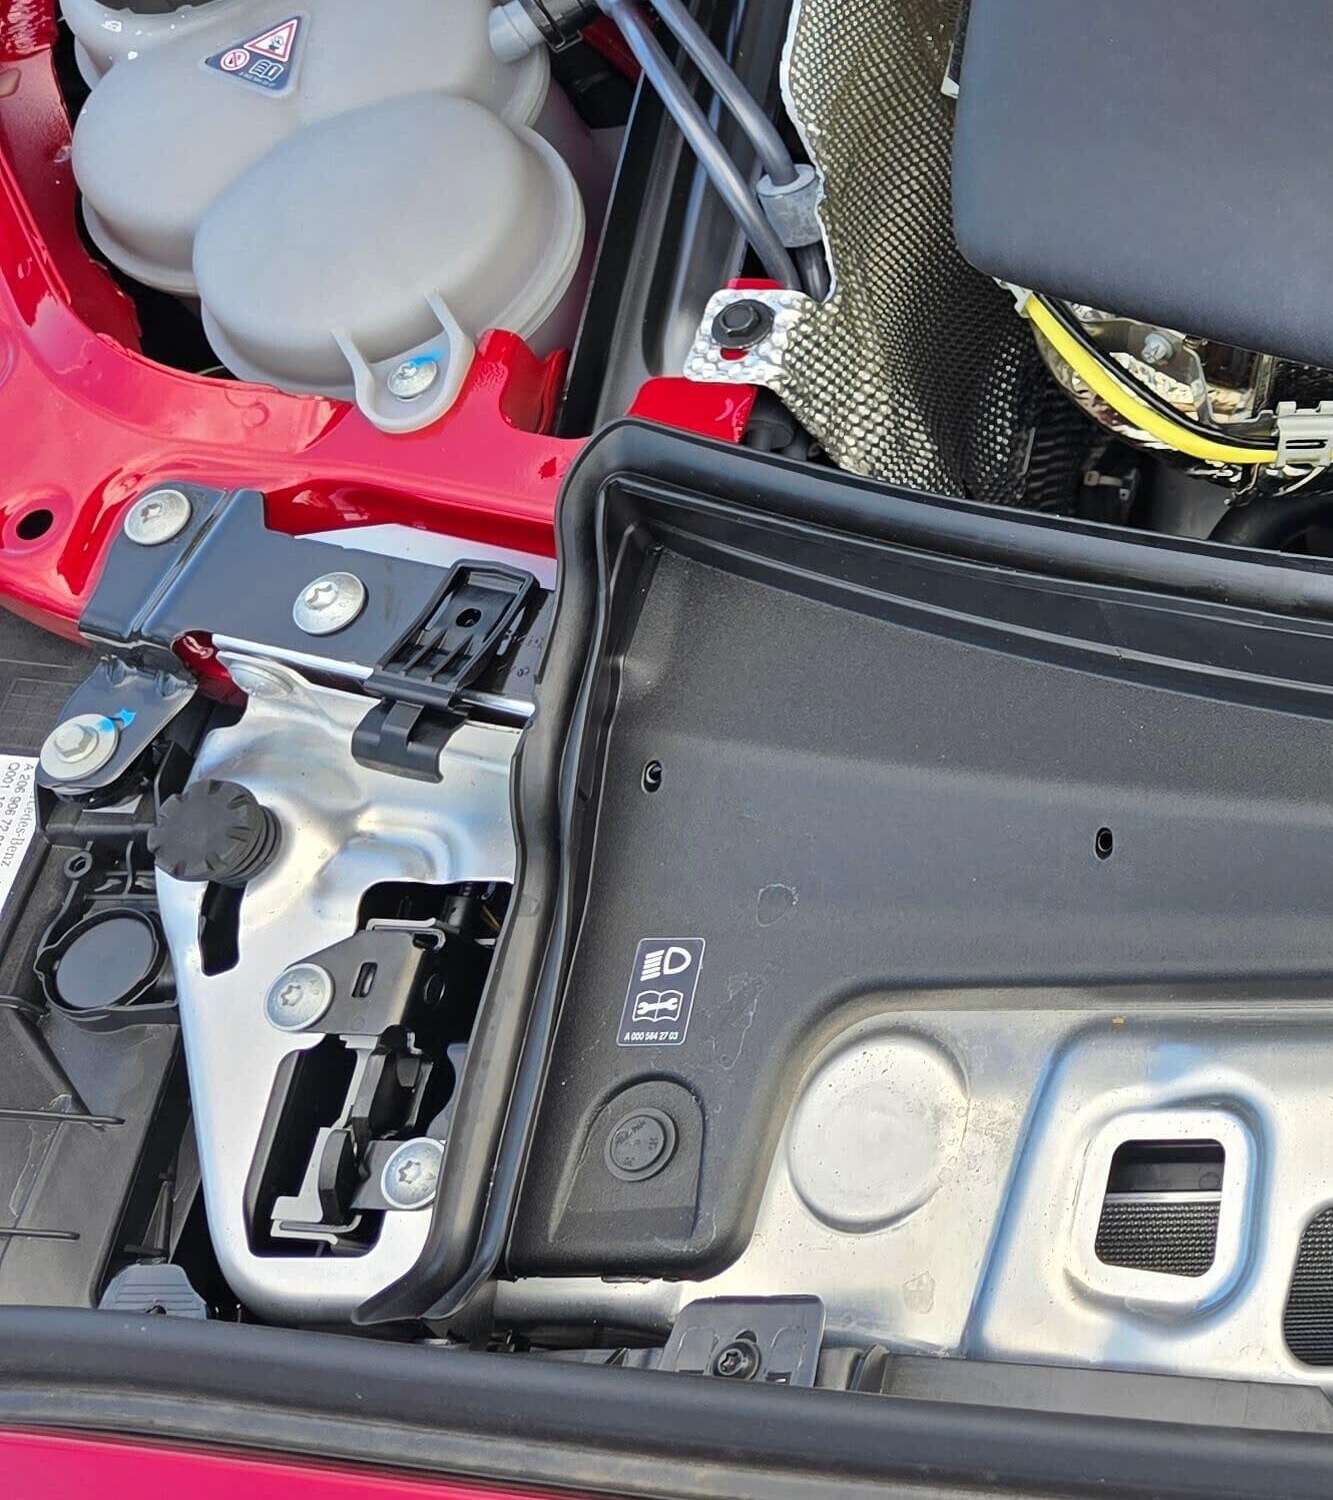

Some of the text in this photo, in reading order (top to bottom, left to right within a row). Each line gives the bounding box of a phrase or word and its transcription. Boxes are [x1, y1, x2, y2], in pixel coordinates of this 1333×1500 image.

[624, 1032, 630, 1040] A
[631, 1032, 644, 1040] 000
[659, 1032, 668, 1040] 27
[669, 1031, 678, 1040] 03
